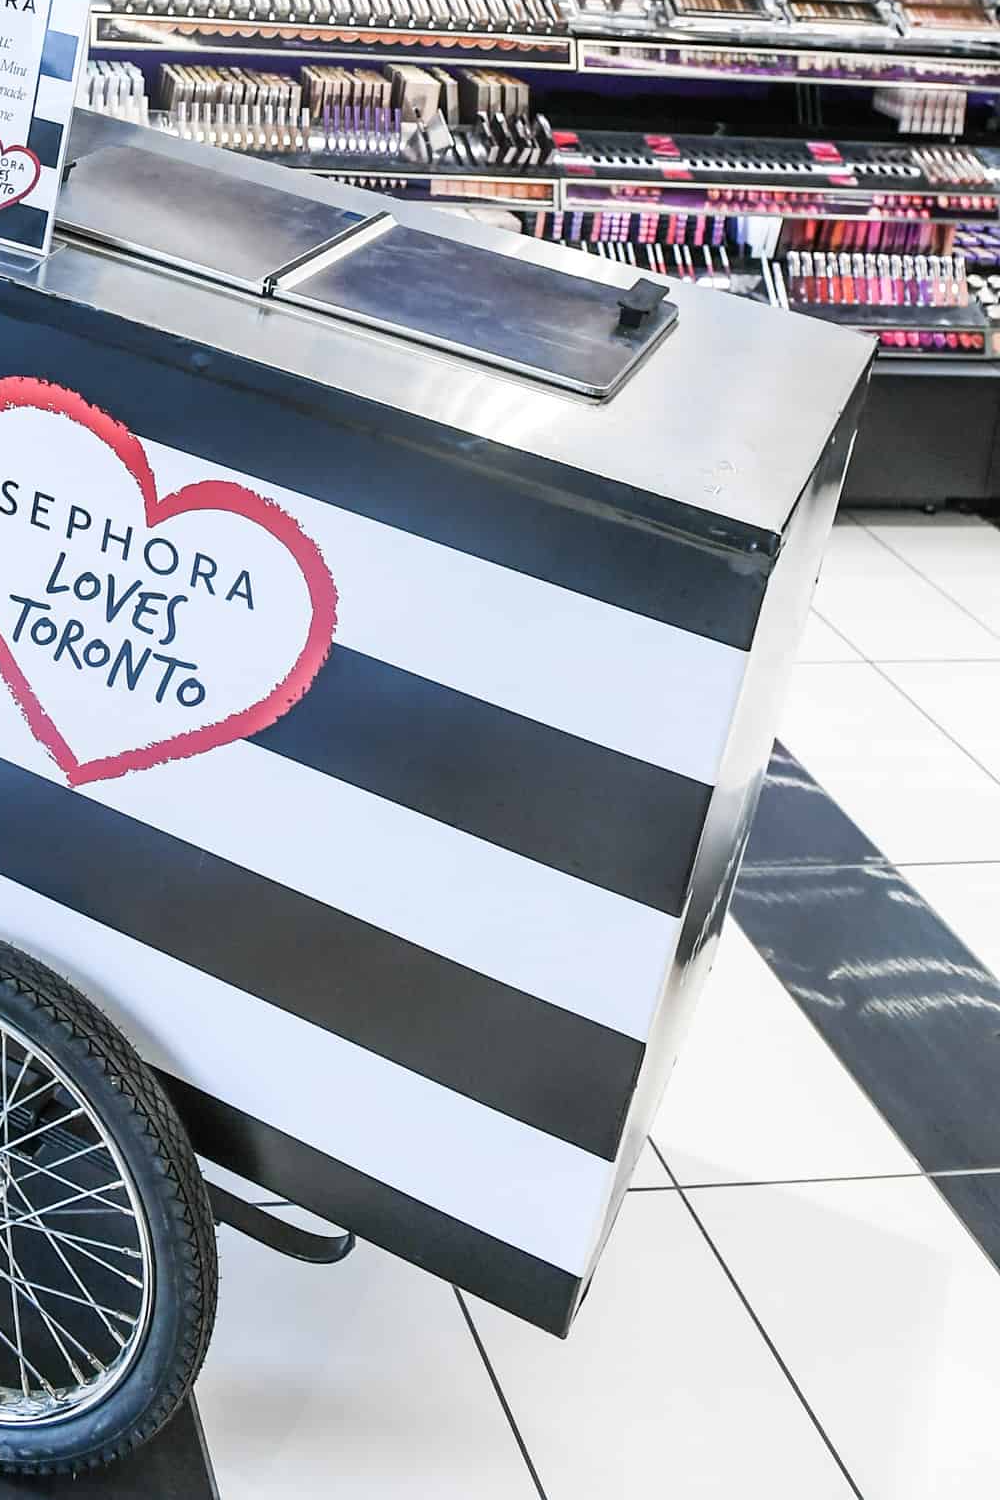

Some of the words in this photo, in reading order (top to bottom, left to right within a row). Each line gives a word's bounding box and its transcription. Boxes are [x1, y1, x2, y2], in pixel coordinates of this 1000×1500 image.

[0, 59, 28, 77] Mint
[45, 551, 189, 645] LOVES
[9, 594, 206, 707] TORONTO
